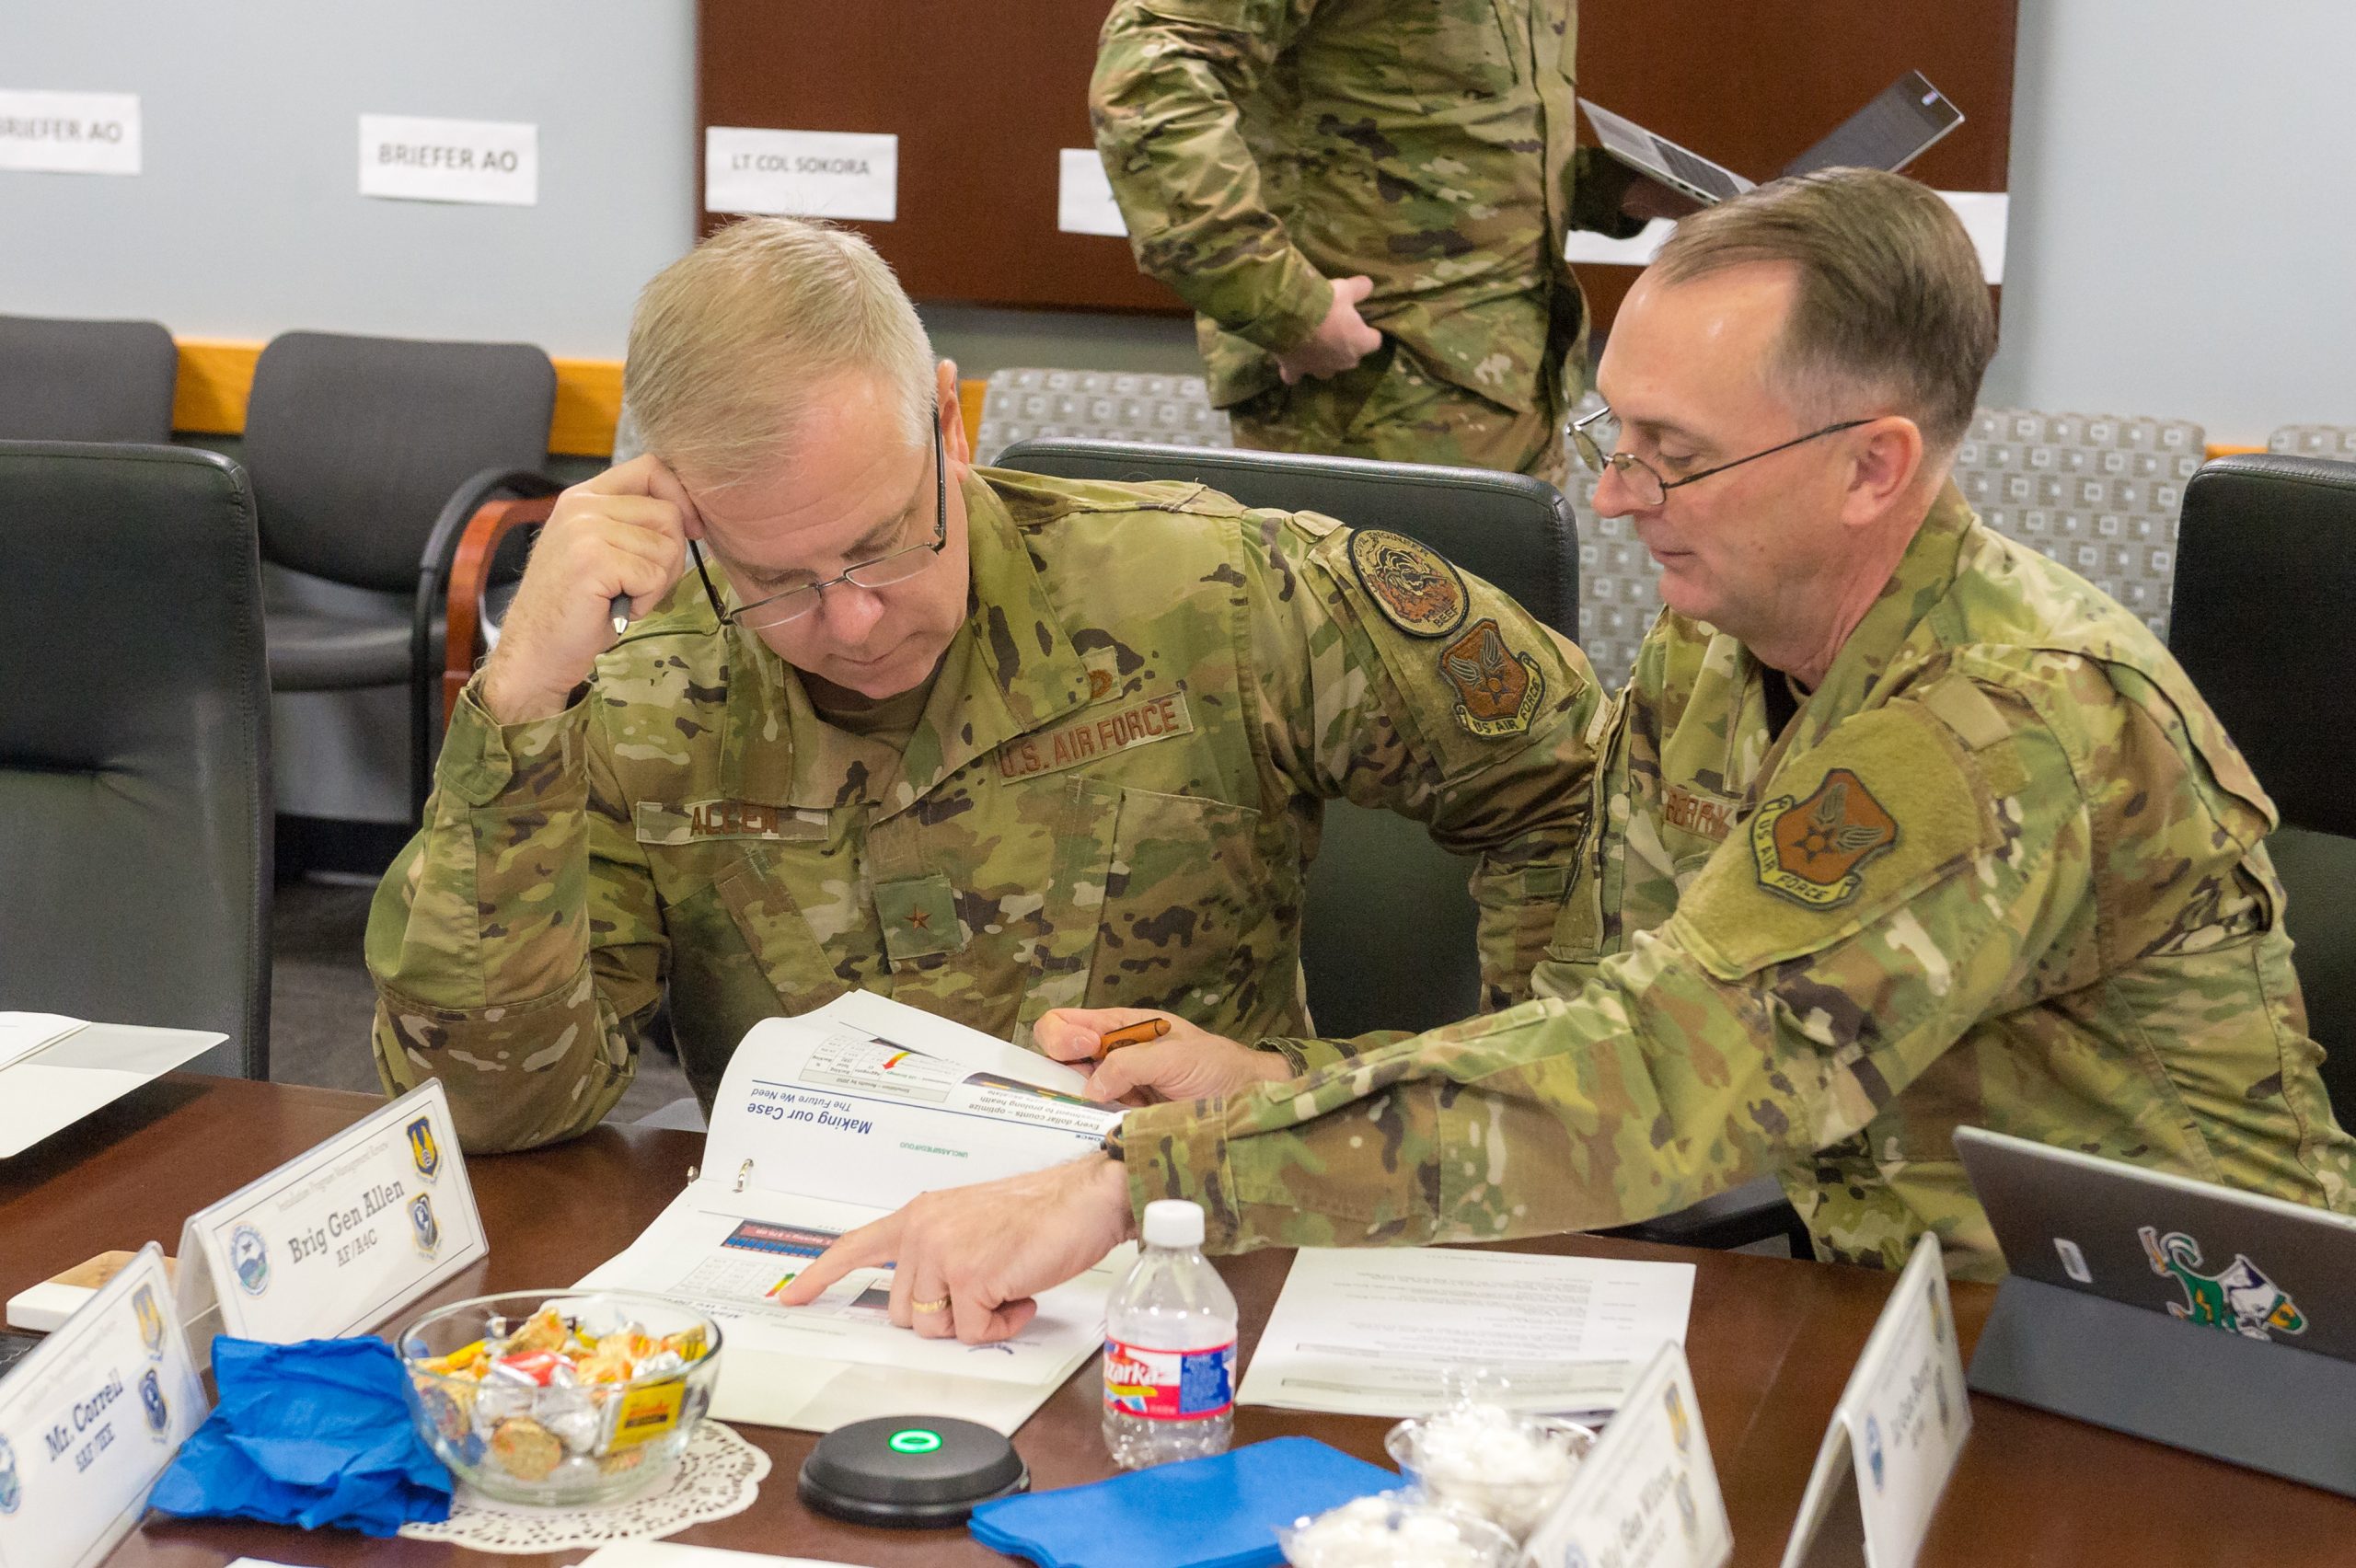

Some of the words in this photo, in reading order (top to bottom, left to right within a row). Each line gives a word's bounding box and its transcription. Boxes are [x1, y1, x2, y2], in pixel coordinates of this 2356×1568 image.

[0, 116, 83, 143] RIEFER
[87, 120, 124, 144] AO
[378, 143, 474, 170] BRIEFER
[481, 150, 518, 173] AO
[732, 153, 751, 171] LT
[756, 154, 789, 173] COL
[1433, 605, 1458, 628] BEEF
[1472, 719, 1492, 734] US
[1496, 720, 1519, 733] AIR
[1519, 677, 1542, 721] FORCE
[998, 740, 1050, 778] U.S.
[1051, 725, 1096, 767] AIR
[1097, 698, 1181, 751] FORCE
[1757, 819, 1772, 841] US
[1760, 845, 1776, 872] AIR
[1773, 874, 1829, 901] FORCE
[750, 1088, 779, 1100] Need
[780, 1092, 795, 1103] We
[798, 1093, 830, 1109] Future
[980, 1096, 1008, 1105] health
[746, 1102, 783, 1121] Case
[787, 1109, 814, 1123] our
[833, 1101, 852, 1113] The
[968, 1103, 1006, 1115] optimize
[1009, 1100, 1044, 1113] prolong
[1015, 1111, 1045, 1123] counts
[817, 1112, 873, 1135] Making
[1046, 1115, 1073, 1126] dollar
[1073, 1120, 1100, 1131] Every
[288, 1226, 328, 1265] Brig
[328, 1205, 364, 1239] Gen
[363, 1180, 405, 1218] Allen
[336, 1229, 378, 1268] AF/A4C
[1104, 1355, 1156, 1386] zarka
[45, 1424, 75, 1462] Mr.
[73, 1367, 123, 1434] Correll
